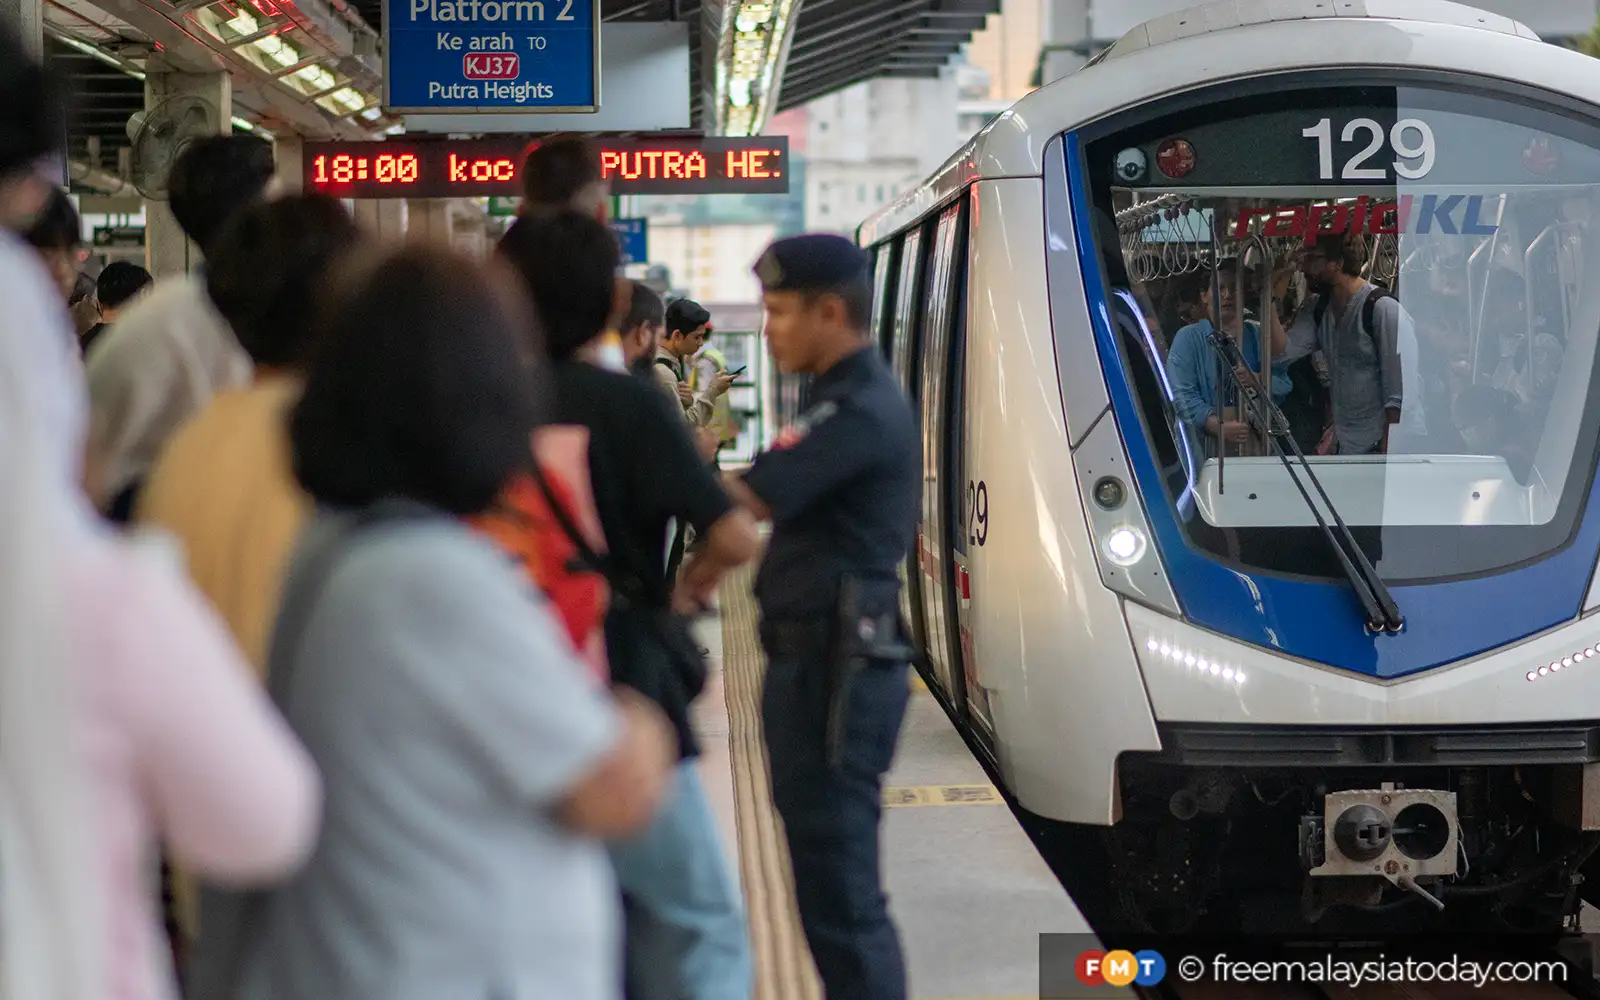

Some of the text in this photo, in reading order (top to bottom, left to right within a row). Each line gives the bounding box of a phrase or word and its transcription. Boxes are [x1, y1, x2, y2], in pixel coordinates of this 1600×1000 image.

[410, 0, 575, 21] Platform 2
[437, 32, 547, 50] Ke arah TO
[466, 57, 517, 75] KJ37
[429, 81, 554, 103] Putra Heights
[1302, 118, 1436, 180] 129
[314, 153, 418, 183] 18:00
[449, 153, 515, 182] koc
[600, 151, 707, 180] PUTRA
[1234, 194, 1501, 245] rapidKL
